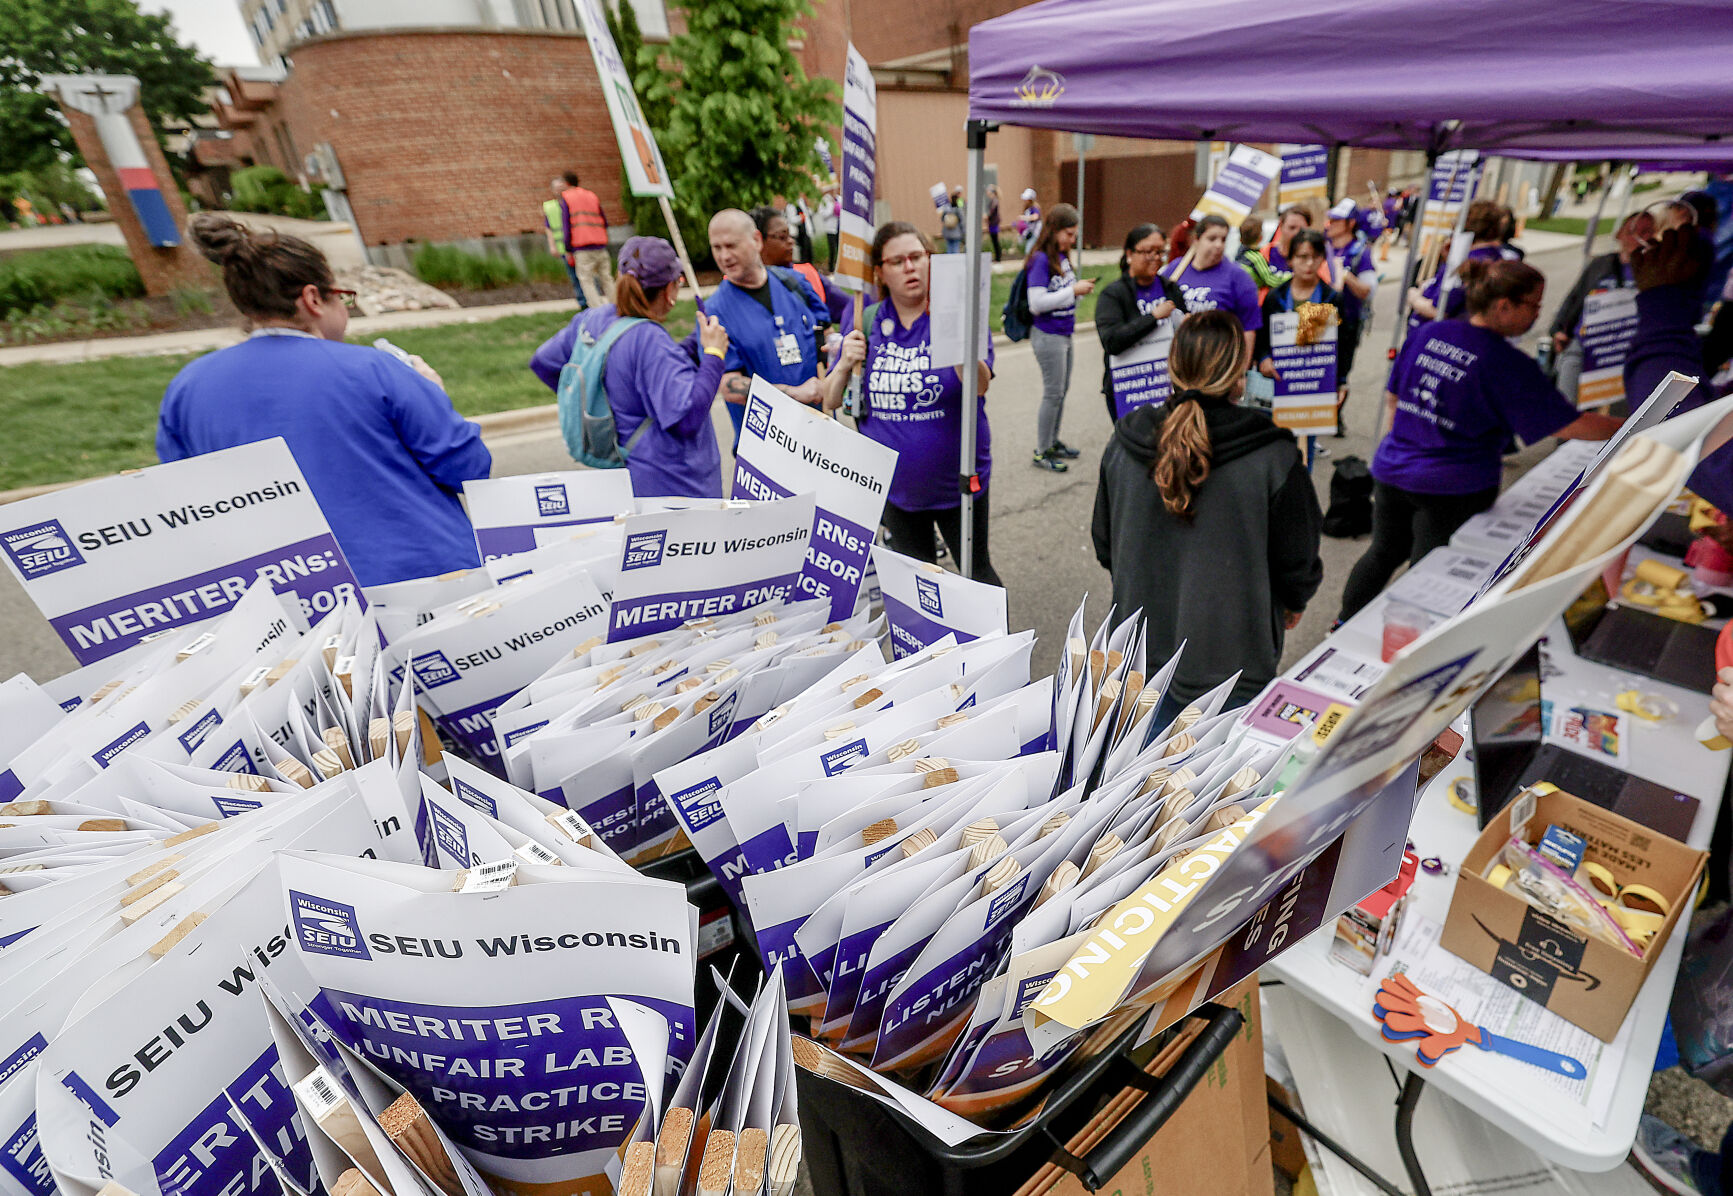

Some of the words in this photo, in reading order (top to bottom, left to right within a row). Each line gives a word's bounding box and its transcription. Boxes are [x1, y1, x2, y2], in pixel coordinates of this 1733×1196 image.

[872, 356, 929, 373] STAFFING
[1425, 338, 1478, 366] RESPECT
[869, 371, 923, 393] SAVES
[1415, 353, 1467, 382] PROTECT
[869, 392, 906, 410] LIVES
[768, 424, 797, 452] SEIU
[802, 445, 882, 493] Wisconsin
[77, 518, 152, 551] SEIU
[157, 479, 300, 529] Wisconsin
[6, 525, 57, 543] Wisconsin
[666, 542, 715, 557] SEIU
[724, 527, 807, 554] Wisconsin
[816, 518, 865, 556] RNs:
[21, 546, 71, 570] SEIU
[626, 550, 659, 563] SEIU
[69, 576, 249, 650] MERITER
[616, 596, 740, 629] MERITER
[743, 584, 793, 608] RNs:
[455, 647, 502, 671] SEIU
[505, 602, 604, 652] Wisconsin
[420, 667, 452, 683] SEIU
[184, 712, 217, 742] Wisconsin
[102, 726, 146, 761] Wisconsin
[826, 743, 863, 763] Wisconsin
[459, 783, 493, 808] Wisconsin
[677, 781, 716, 802] Wisconsin
[434, 805, 463, 831] Wisconsin
[438, 830, 466, 858] SEIU
[297, 899, 349, 919] Wisconsin
[303, 929, 356, 948] SEIU
[306, 941, 333, 951] Stronger
[369, 933, 463, 959] SEIU
[475, 930, 681, 958] Wisconsin
[885, 953, 986, 1036] LISTEN
[339, 1001, 564, 1041] MERITER
[105, 999, 213, 1099] SEIU
[363, 1038, 526, 1079] UNFAIR
[545, 1045, 686, 1077] LABR
[0, 1046, 38, 1082] onsin
[431, 1082, 646, 1113] PRACTICE
[473, 1114, 624, 1144] STRIKE
